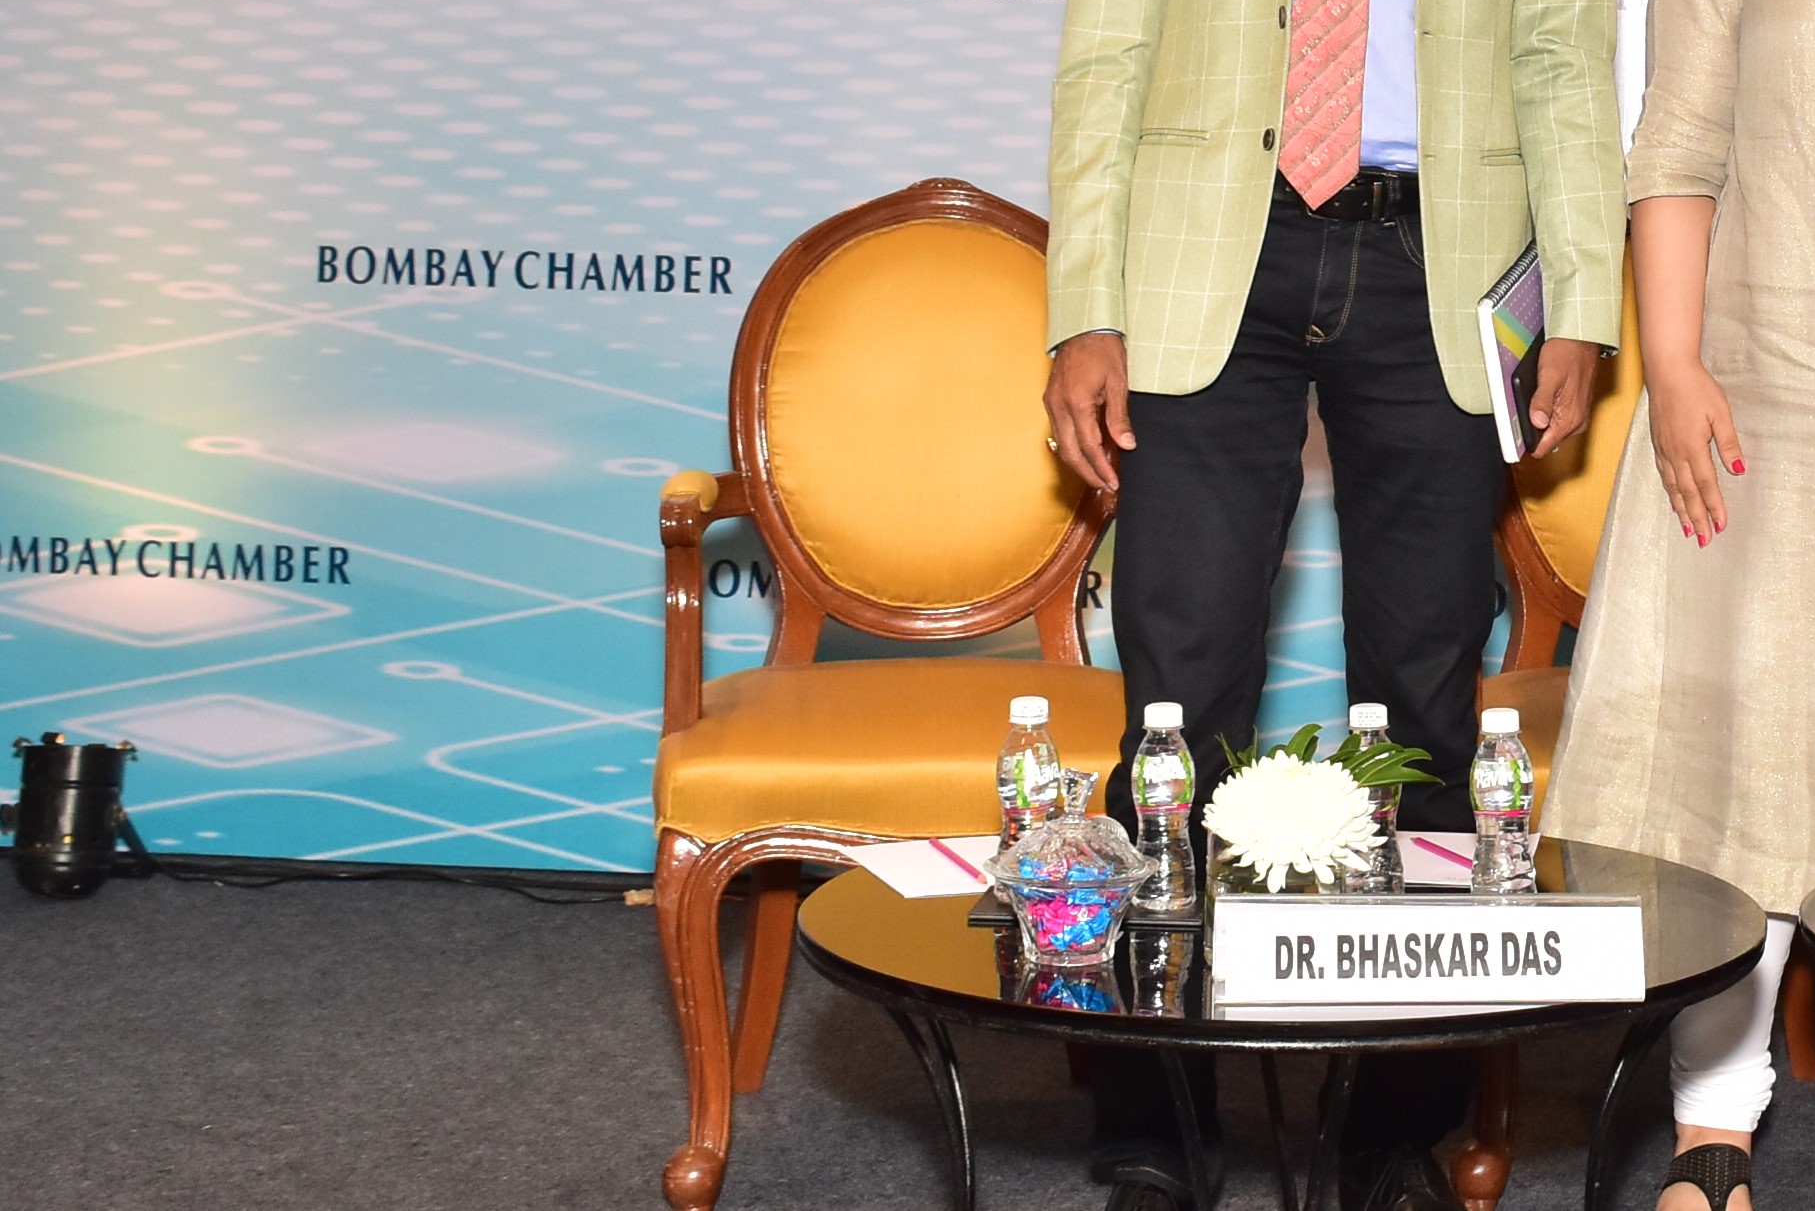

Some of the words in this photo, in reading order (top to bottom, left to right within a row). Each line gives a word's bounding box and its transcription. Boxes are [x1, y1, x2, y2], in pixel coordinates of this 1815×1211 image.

[0, 534, 127, 575] MBAY
[1276, 936, 1324, 979] DR.
[1337, 933, 1490, 979] BHASKAR
[1501, 931, 1561, 976] DAS
